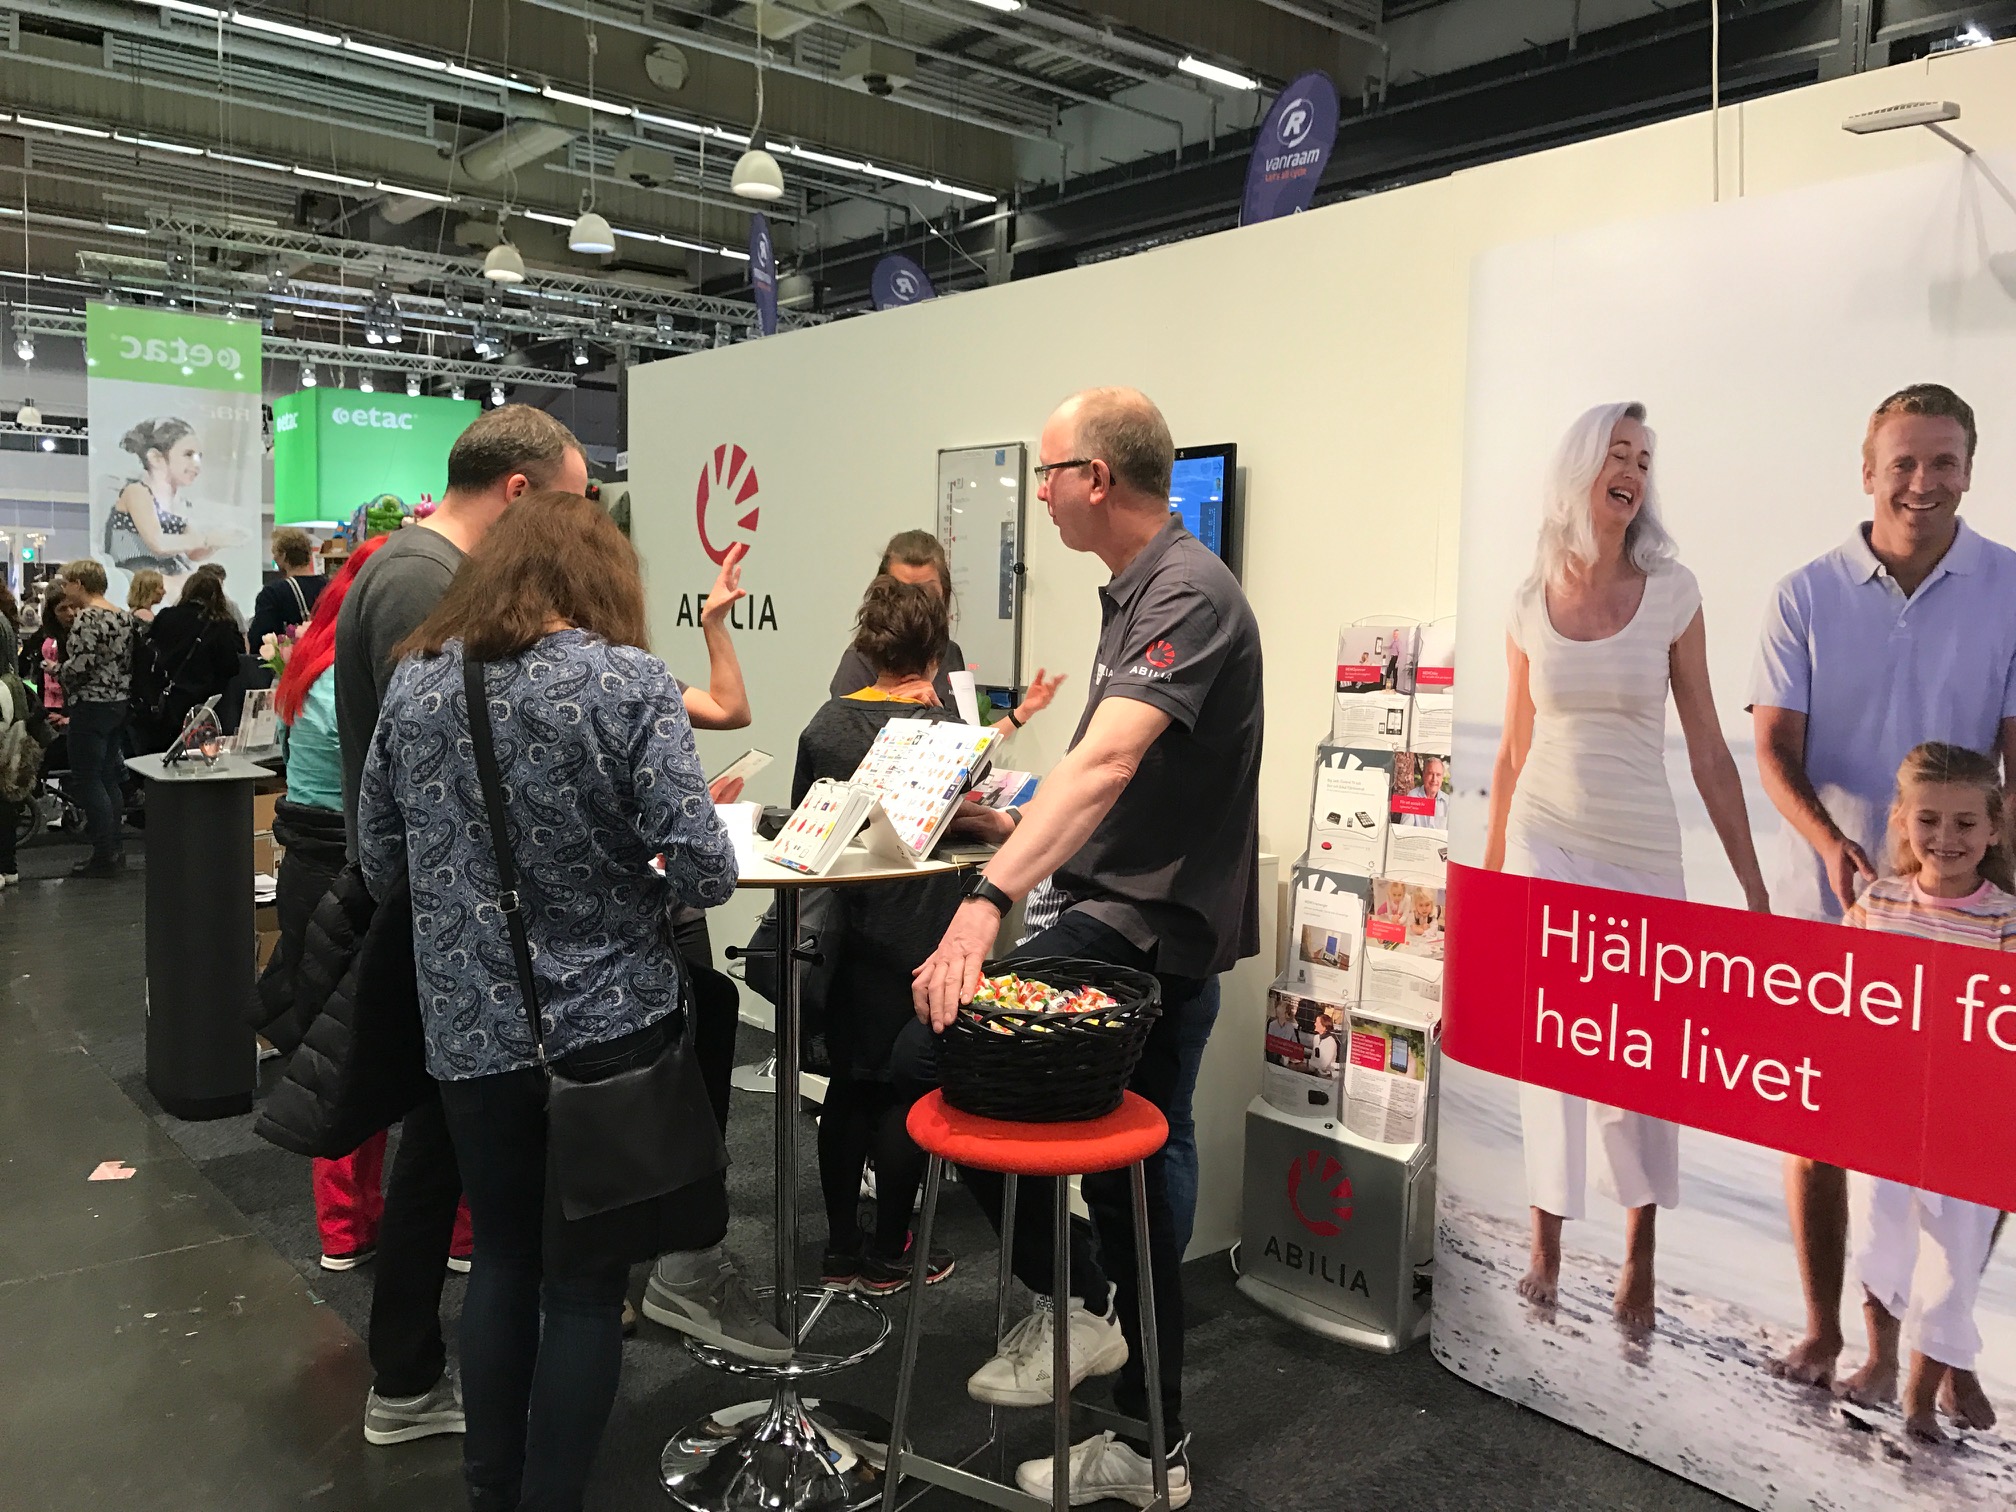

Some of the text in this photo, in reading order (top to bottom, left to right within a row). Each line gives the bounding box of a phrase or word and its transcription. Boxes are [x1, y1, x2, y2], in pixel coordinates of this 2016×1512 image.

[1283, 110, 1306, 137] R
[1265, 148, 1320, 172] vanraam
[351, 407, 413, 430] etac
[676, 593, 778, 631] ABLIA
[1541, 904, 1923, 1032] Hjälpmedel
[1536, 987, 1822, 1111] hela livet
[1264, 1235, 1370, 1298] ABILIA
